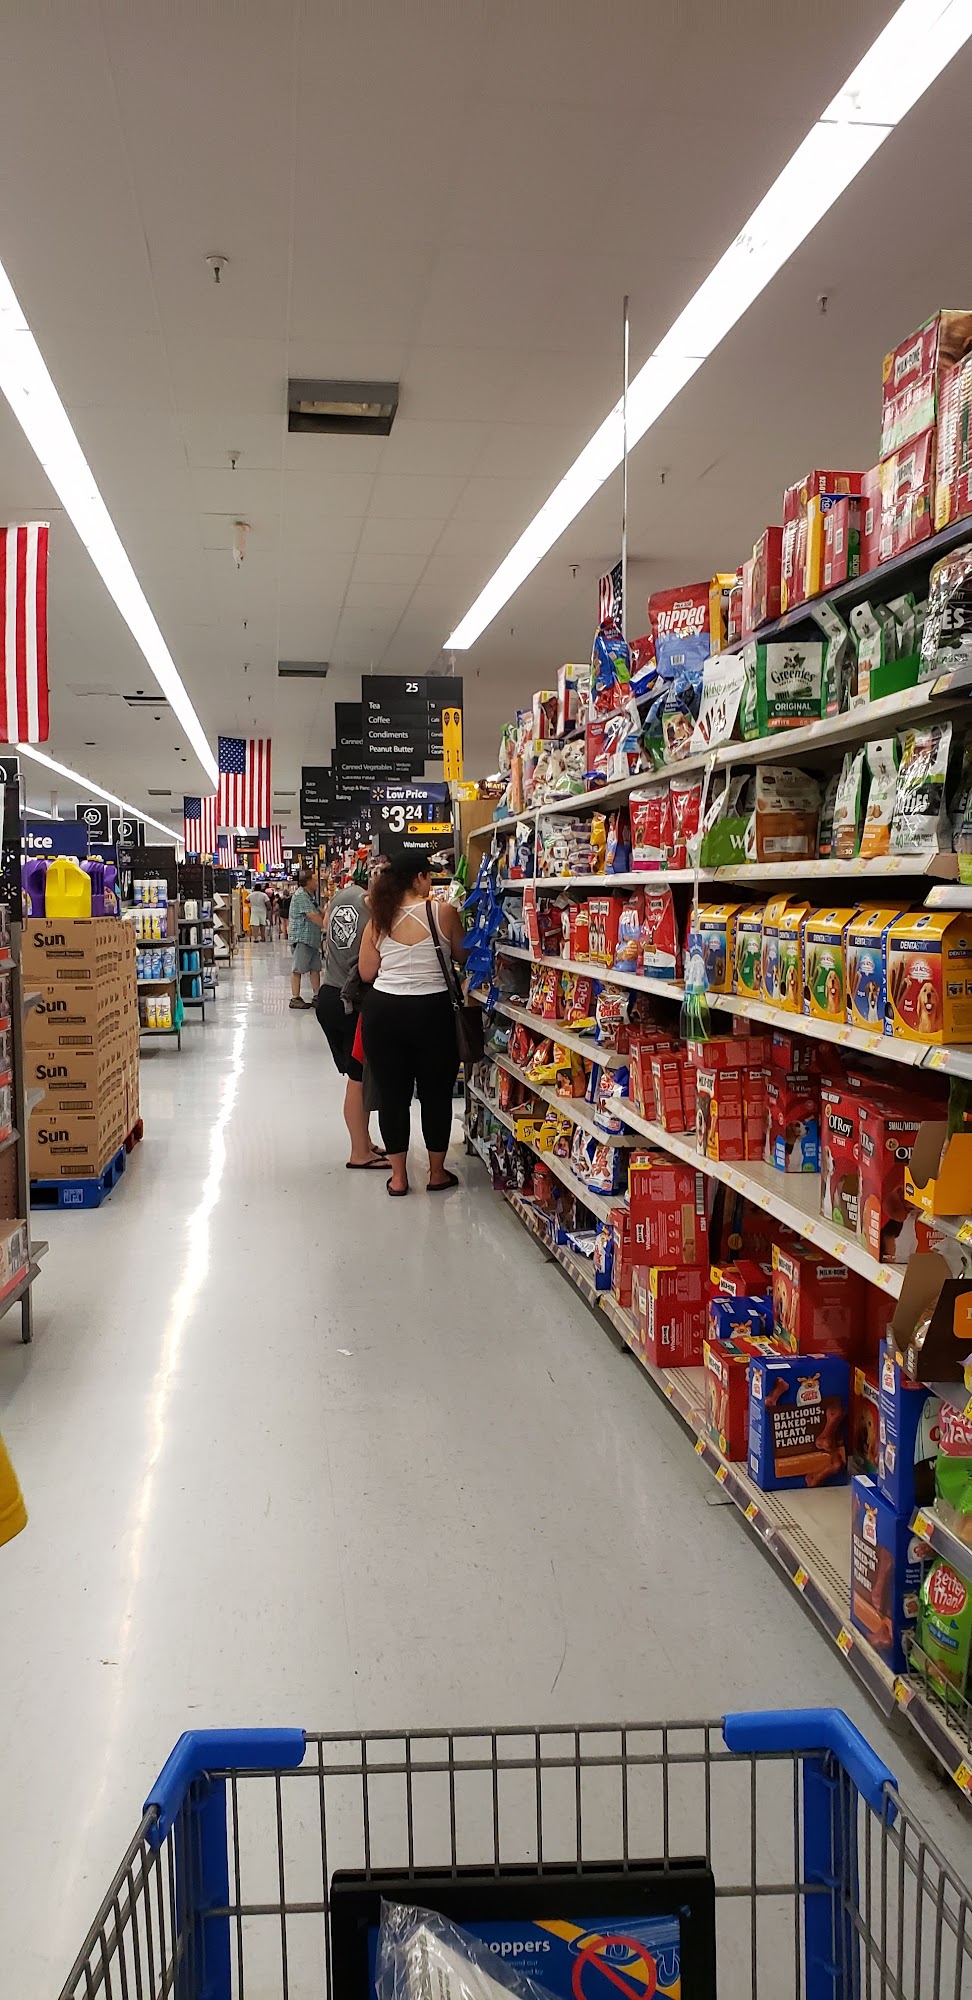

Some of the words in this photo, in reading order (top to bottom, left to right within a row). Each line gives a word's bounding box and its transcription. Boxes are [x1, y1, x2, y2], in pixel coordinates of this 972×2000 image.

[770, 667, 816, 685] Greenies
[405, 682, 419, 693] 25
[368, 701, 381, 710] Tea
[774, 702, 812, 711] ORIGINAL
[368, 716, 391, 724] Coffee
[368, 731, 409, 739] Condiments
[369, 745, 392, 753] Peanut
[393, 745, 415, 753] Butter
[341, 763, 363, 771] Canned
[363, 763, 393, 772] Vegetables
[484, 781, 506, 790] HEATH
[386, 791, 405, 799] Low
[405, 789, 428, 799] Price
[402, 840, 430, 849] Walmart
[33, 932, 66, 948] Sun
[900, 940, 930, 951] DENTASTIX
[574, 980, 590, 1011] Party
[35, 999, 67, 1014] Sun
[36, 1065, 68, 1080] Sun
[38, 1129, 69, 1144] Sun
[819, 1268, 846, 1276] MILK-BONE
[773, 1406, 825, 1422] DELICIOUS,
[774, 1415, 821, 1431] BAKED-IN
[775, 1426, 807, 1440] MEATY
[775, 1434, 815, 1448] FLAVOR!
[853, 1533, 879, 1564] DELICIOUS,
[853, 1545, 877, 1572] BAKED-IN
[853, 1557, 869, 1578] MEATY
[853, 1569, 872, 1593] FLAVOR!
[933, 1585, 964, 1609] Than!
